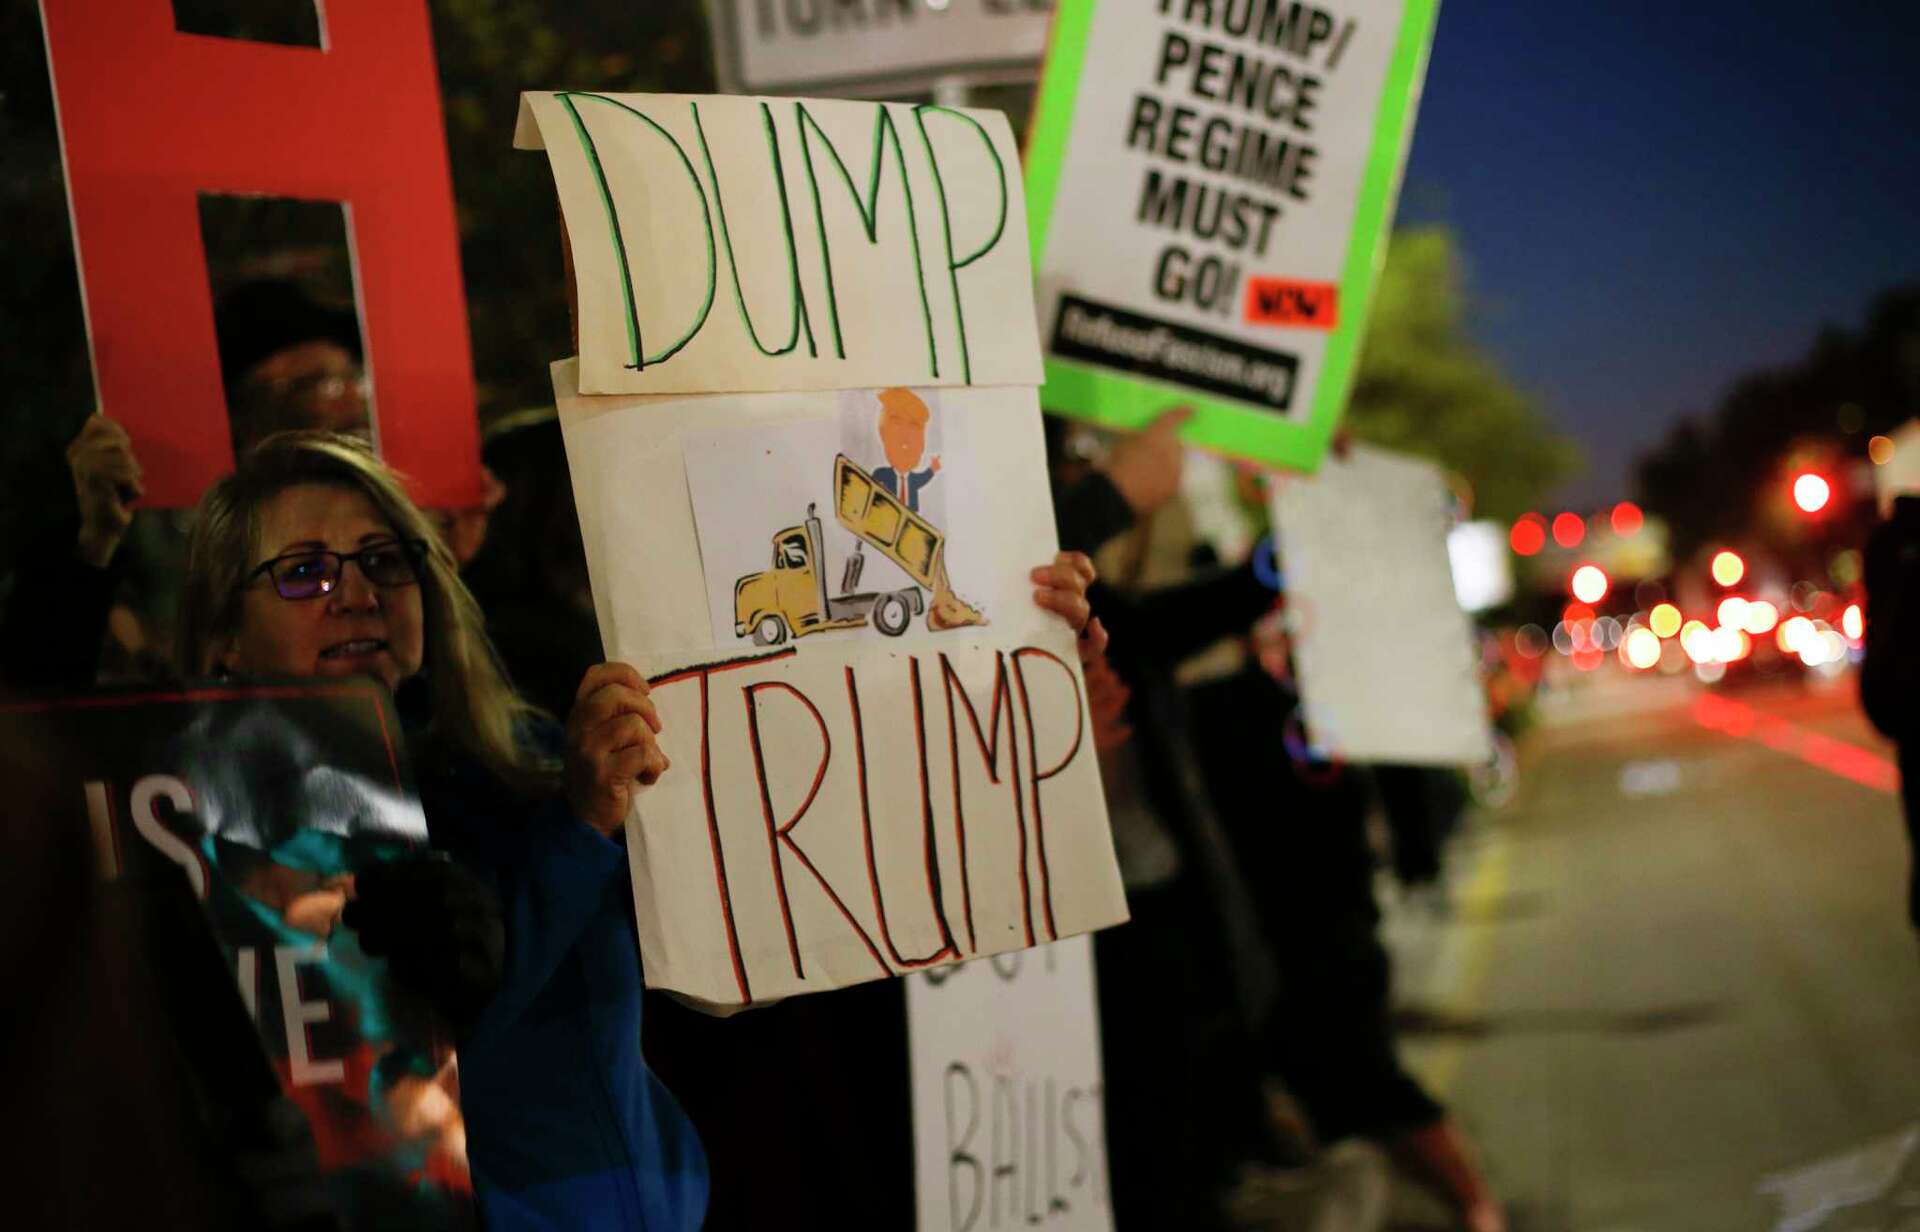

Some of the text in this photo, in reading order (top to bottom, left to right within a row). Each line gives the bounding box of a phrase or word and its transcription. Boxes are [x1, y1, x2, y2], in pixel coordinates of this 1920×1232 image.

[1155, 31, 1322, 132] PENCE
[1126, 94, 1319, 202] REGIME
[554, 92, 1007, 386] DUMP
[1136, 169, 1282, 259] MUST
[1152, 245, 1241, 319] GO!
[649, 645, 1083, 1006] TRUMP
